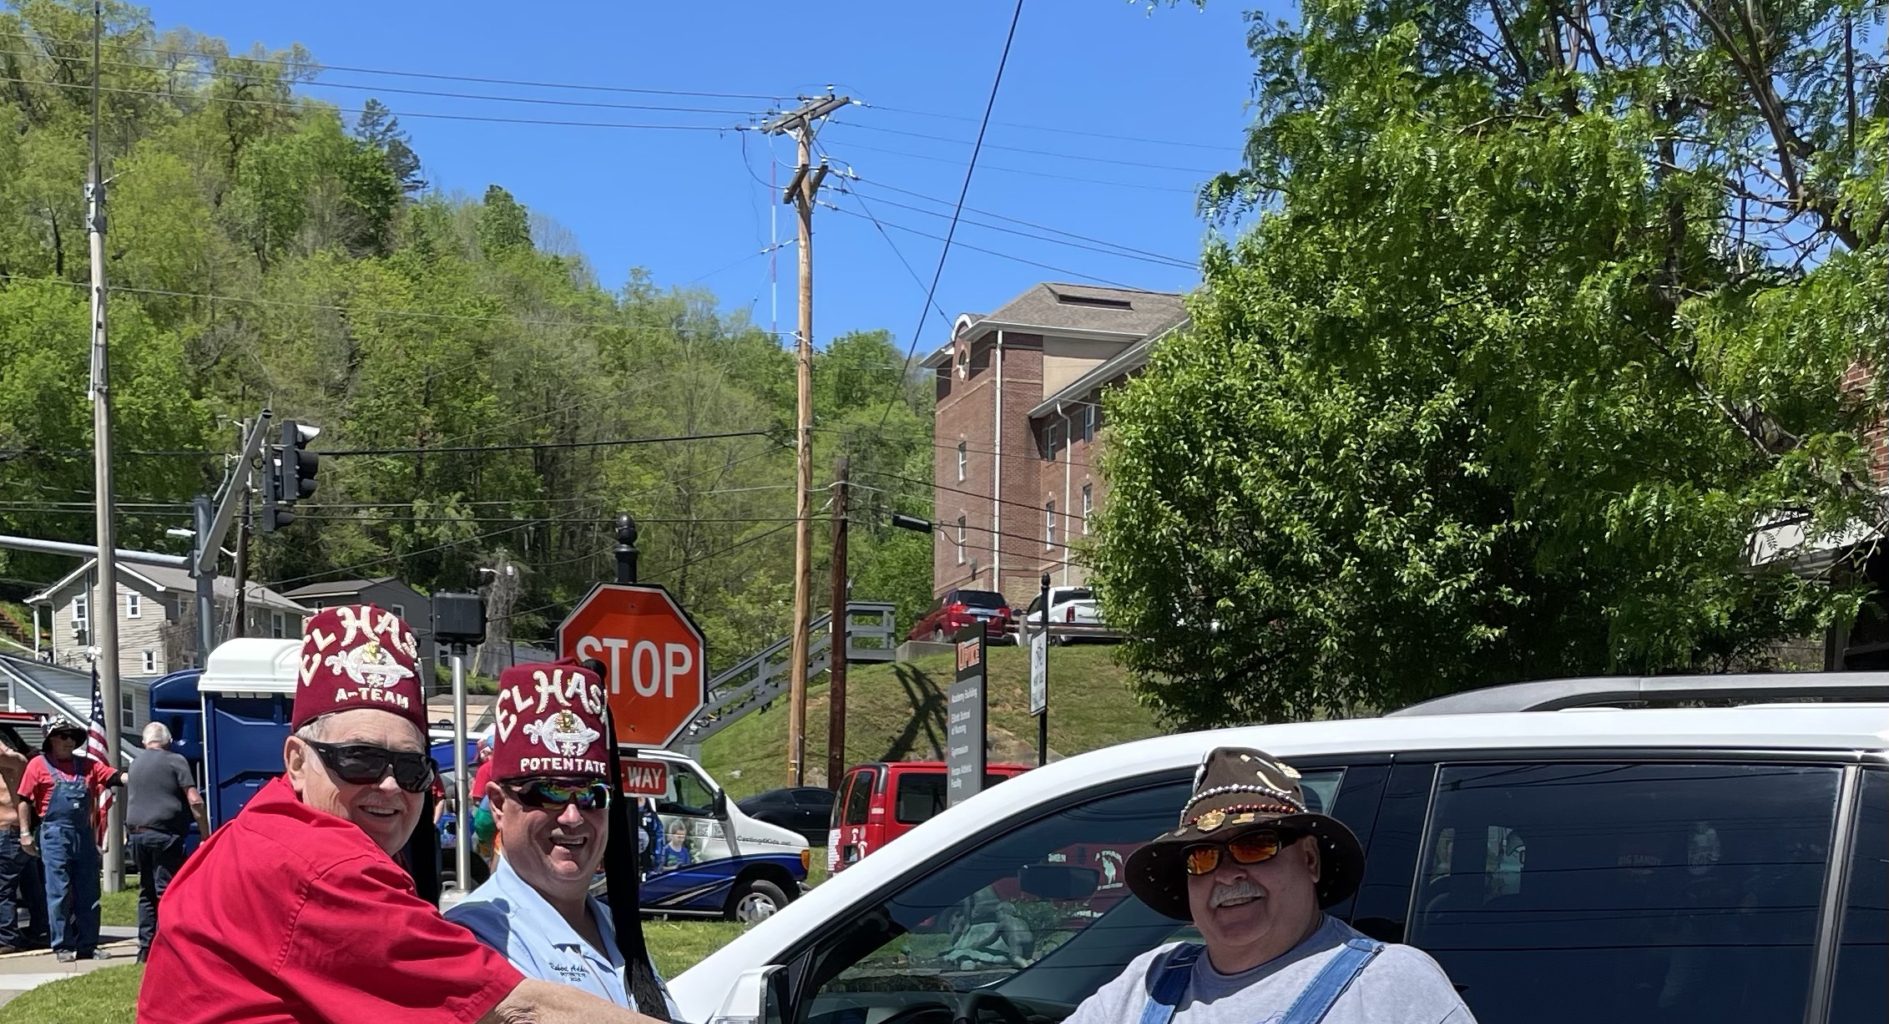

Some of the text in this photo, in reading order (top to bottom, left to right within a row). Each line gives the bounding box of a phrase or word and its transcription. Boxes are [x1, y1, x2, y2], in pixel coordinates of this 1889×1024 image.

[576, 635, 693, 699] STOP
[335, 687, 409, 709] A-TEAM
[496, 685, 534, 743] EL
[520, 757, 607, 776] POTENTATE
